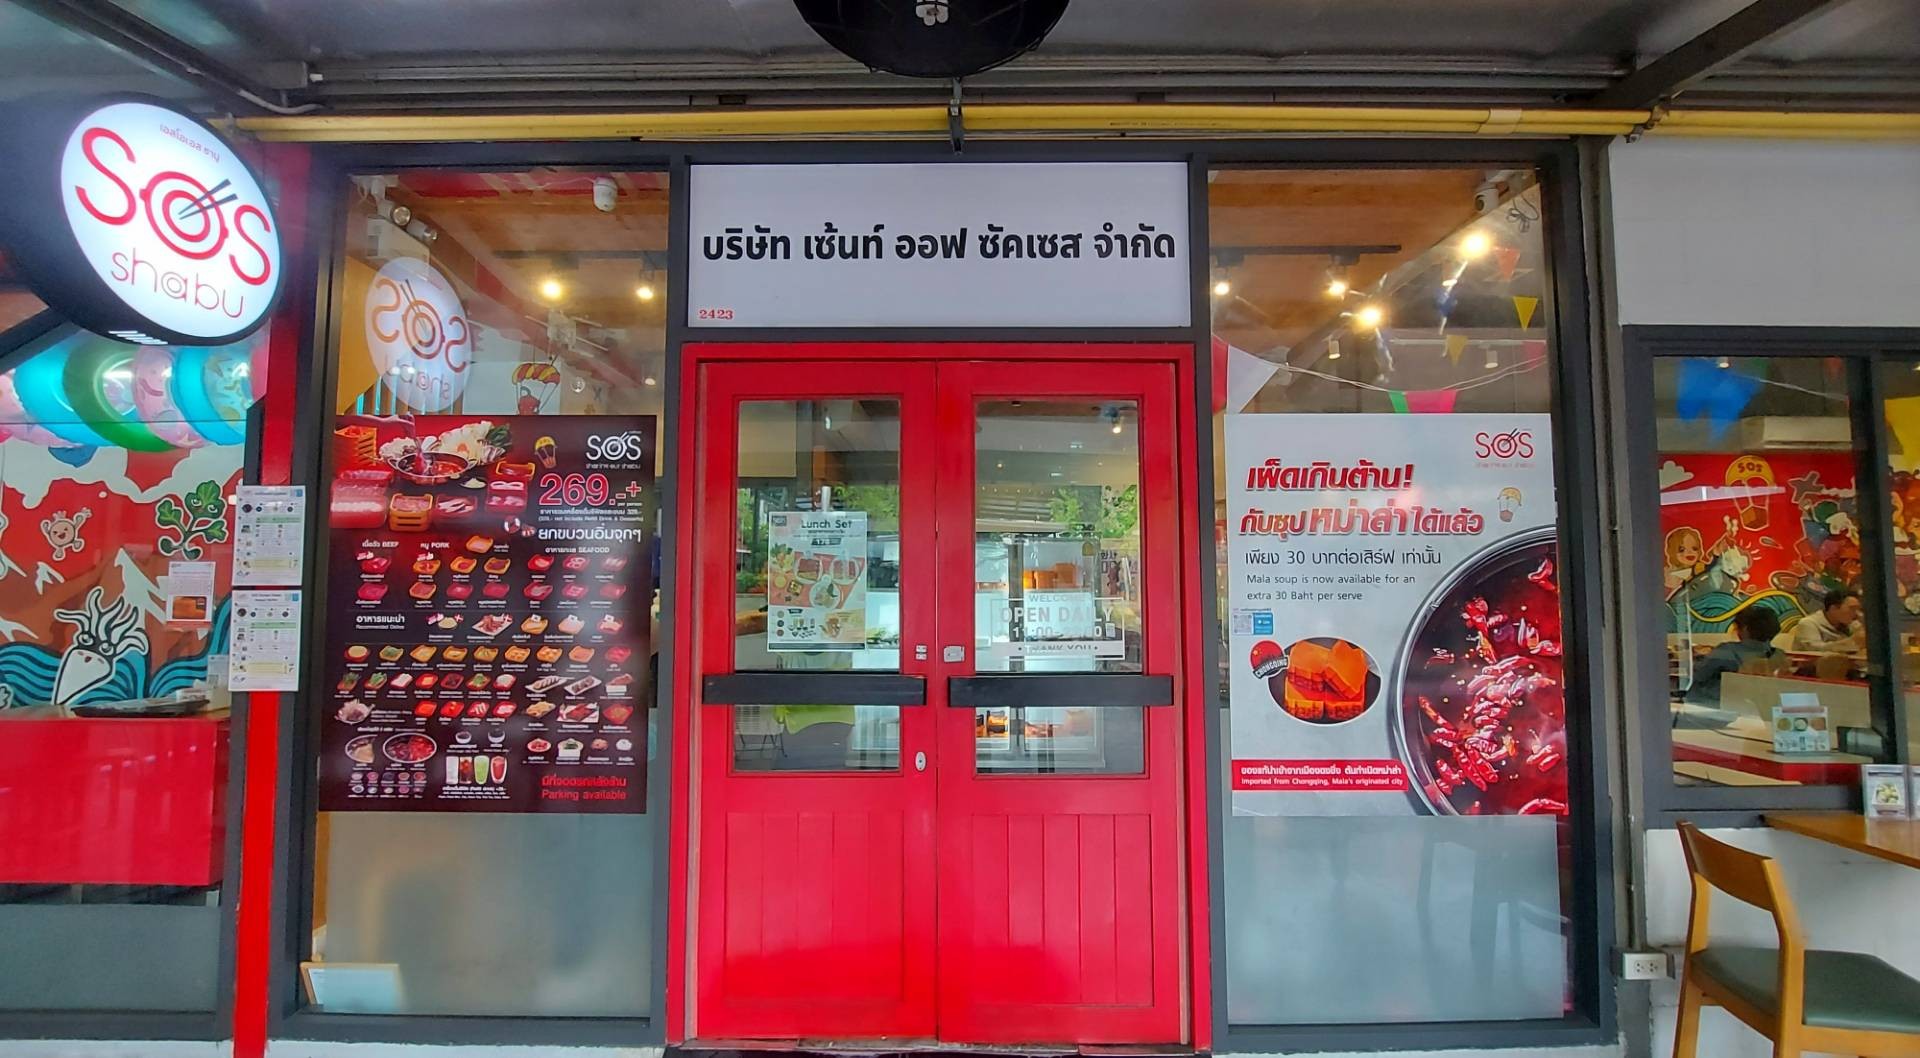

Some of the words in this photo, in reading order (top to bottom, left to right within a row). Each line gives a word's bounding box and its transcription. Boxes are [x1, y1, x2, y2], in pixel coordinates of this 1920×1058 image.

[75, 127, 271, 286] SOS
[703, 224, 791, 260] บริษัท
[804, 222, 885, 260] เซ้นท์
[895, 228, 968, 259] ออฟ
[978, 224, 1083, 259] ซัคเซส
[1094, 222, 1176, 259] จำกัด
[111, 247, 244, 318] shabu
[699, 309, 734, 320] 2423
[586, 431, 642, 461] SOS
[1475, 428, 1533, 459] SOS
[1246, 457, 1414, 490] เผ็ดเกินต้าน!
[835, 520, 852, 528] Set
[1245, 548, 1281, 565] เพียง
[1287, 551, 1306, 565] 30
[1312, 548, 1395, 565] บาทต่อเสิร์ฟ
[1402, 545, 1442, 565] เท่านั้น
[1246, 574, 1271, 584] Mala
[1274, 576, 1298, 587] soup
[1302, 574, 1309, 583] is
[1312, 576, 1334, 584] now
[1337, 573, 1381, 584] available
[1384, 573, 1400, 584] for
[1402, 576, 1416, 584] an
[1246, 591, 1272, 600] extra
[1276, 591, 1287, 600] 30
[1291, 591, 1314, 600] Baht
[1317, 593, 1333, 603] per
[1274, 777, 1290, 785] from
[1355, 777, 1389, 786] originated
[1391, 777, 1403, 786] city
[541, 789, 579, 801] Parking
[583, 789, 627, 800] available
